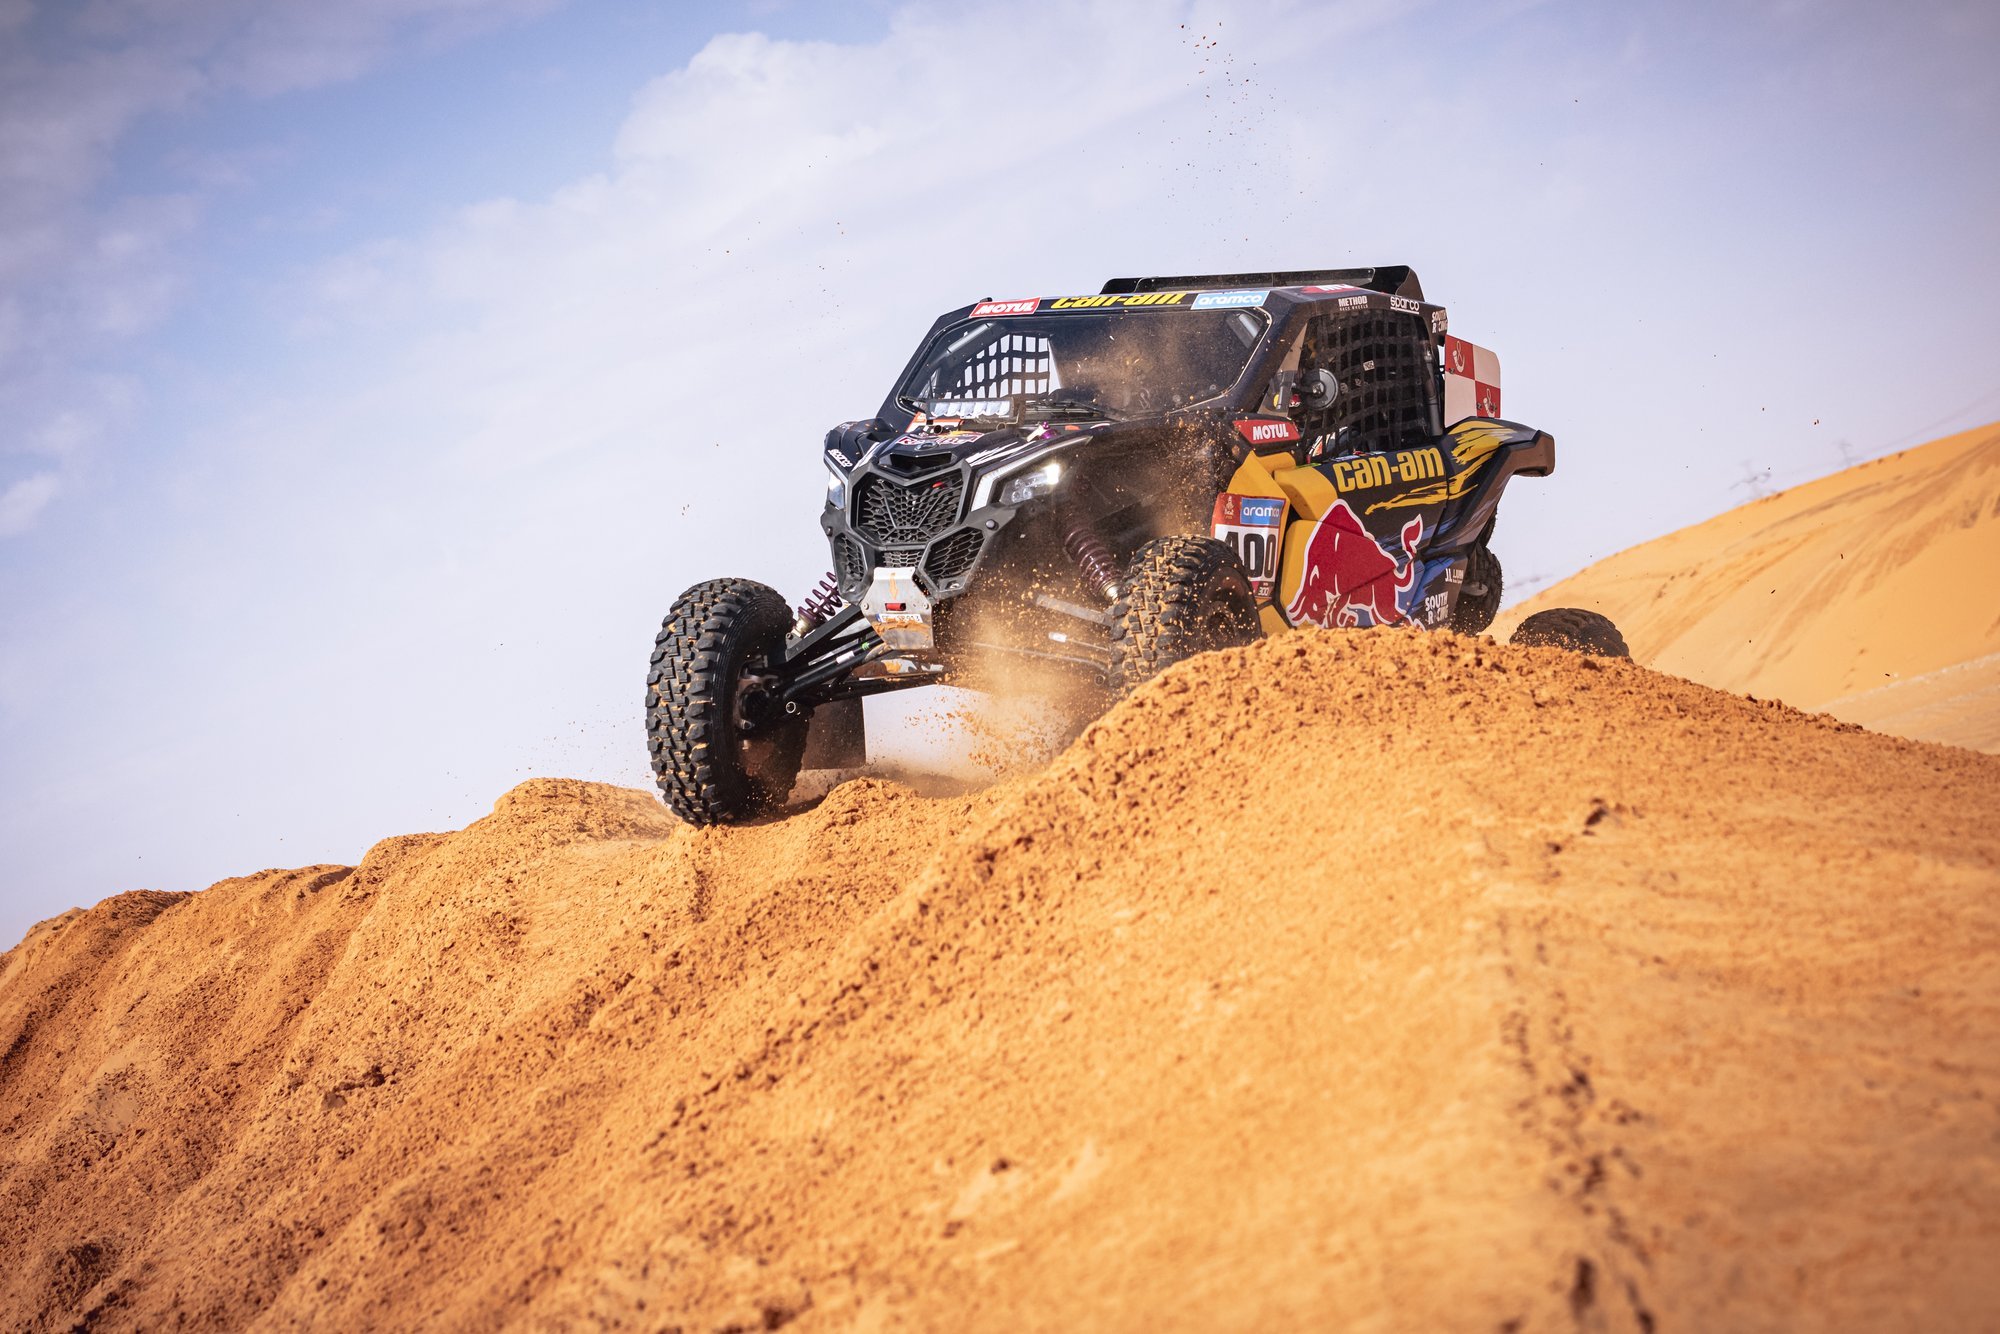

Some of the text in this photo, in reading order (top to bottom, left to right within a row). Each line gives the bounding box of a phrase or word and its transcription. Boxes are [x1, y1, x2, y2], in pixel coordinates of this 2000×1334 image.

[1199, 294, 1262, 305] aramco
[1338, 296, 1368, 307] METHOD
[1390, 296, 1420, 312] sparco
[975, 302, 1034, 314] MOTUL
[1252, 424, 1289, 440] MOTUL
[1332, 447, 1445, 493] can-am
[1425, 591, 1448, 611] SOUTH
